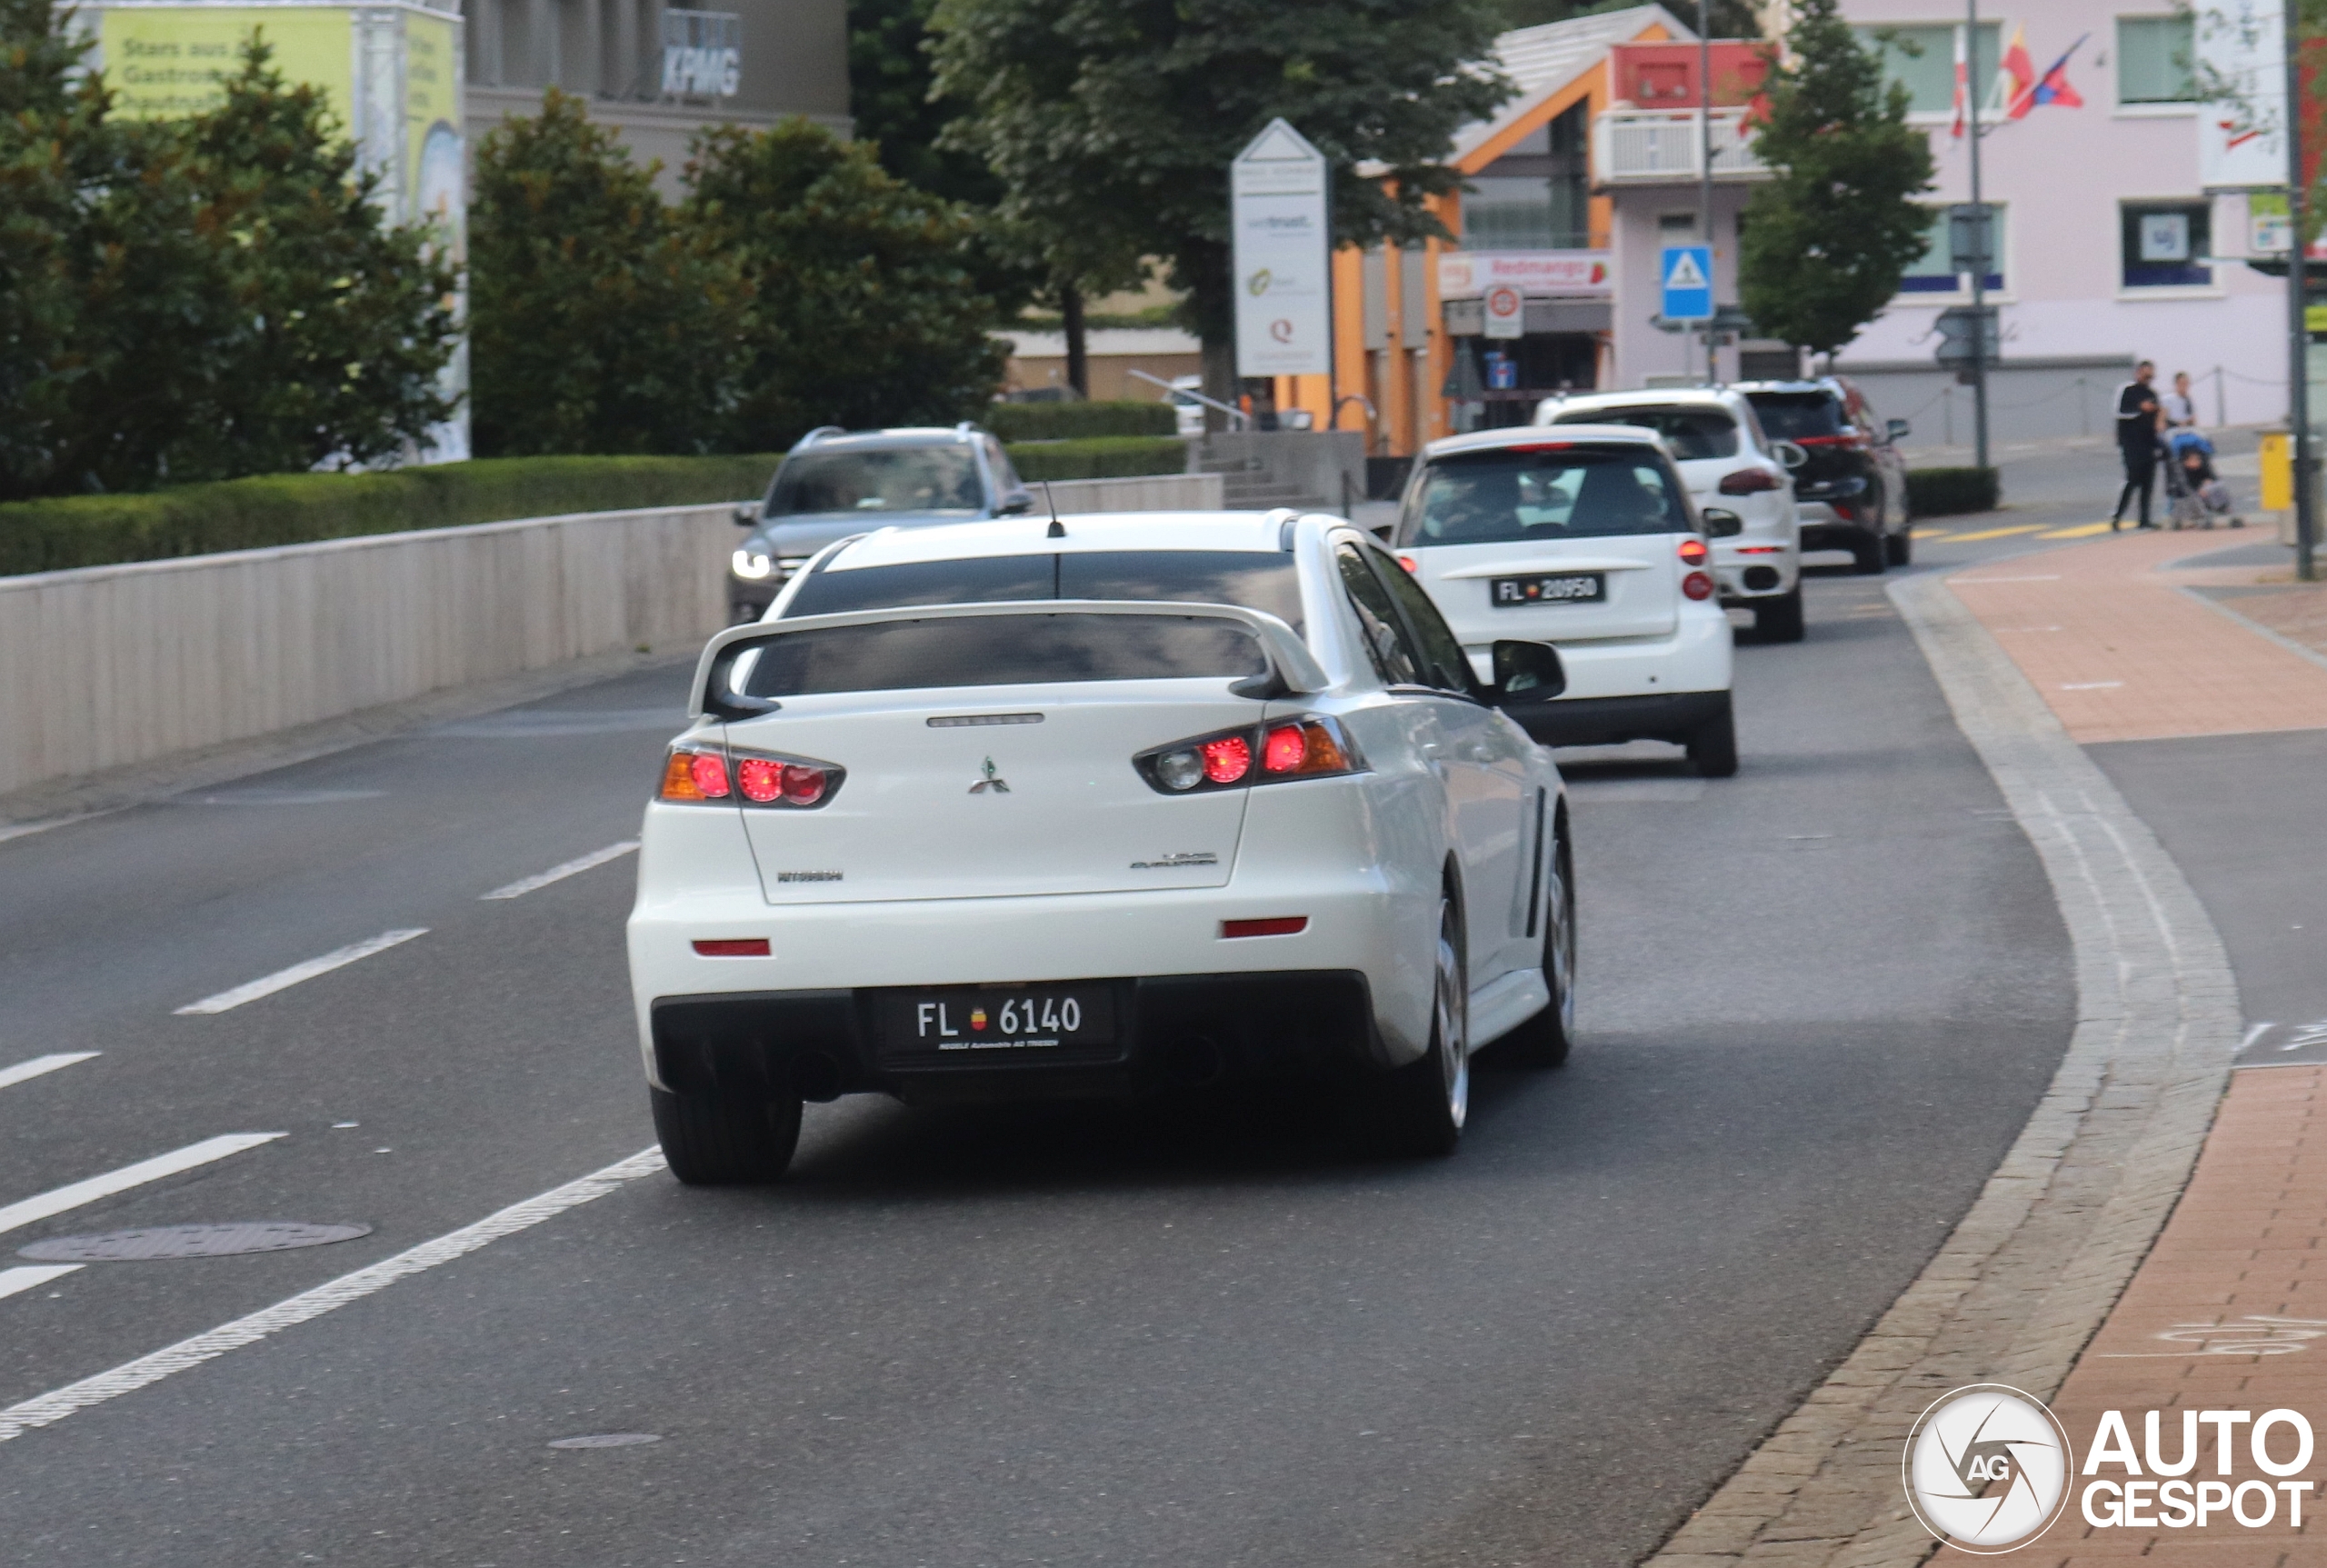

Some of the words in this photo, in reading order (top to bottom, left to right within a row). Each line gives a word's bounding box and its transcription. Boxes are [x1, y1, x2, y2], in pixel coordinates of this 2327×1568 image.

[662, 46, 741, 95] KPMG
[1499, 581, 1524, 601] FL
[916, 1003, 959, 1037] FL
[999, 997, 1082, 1035] 6140
